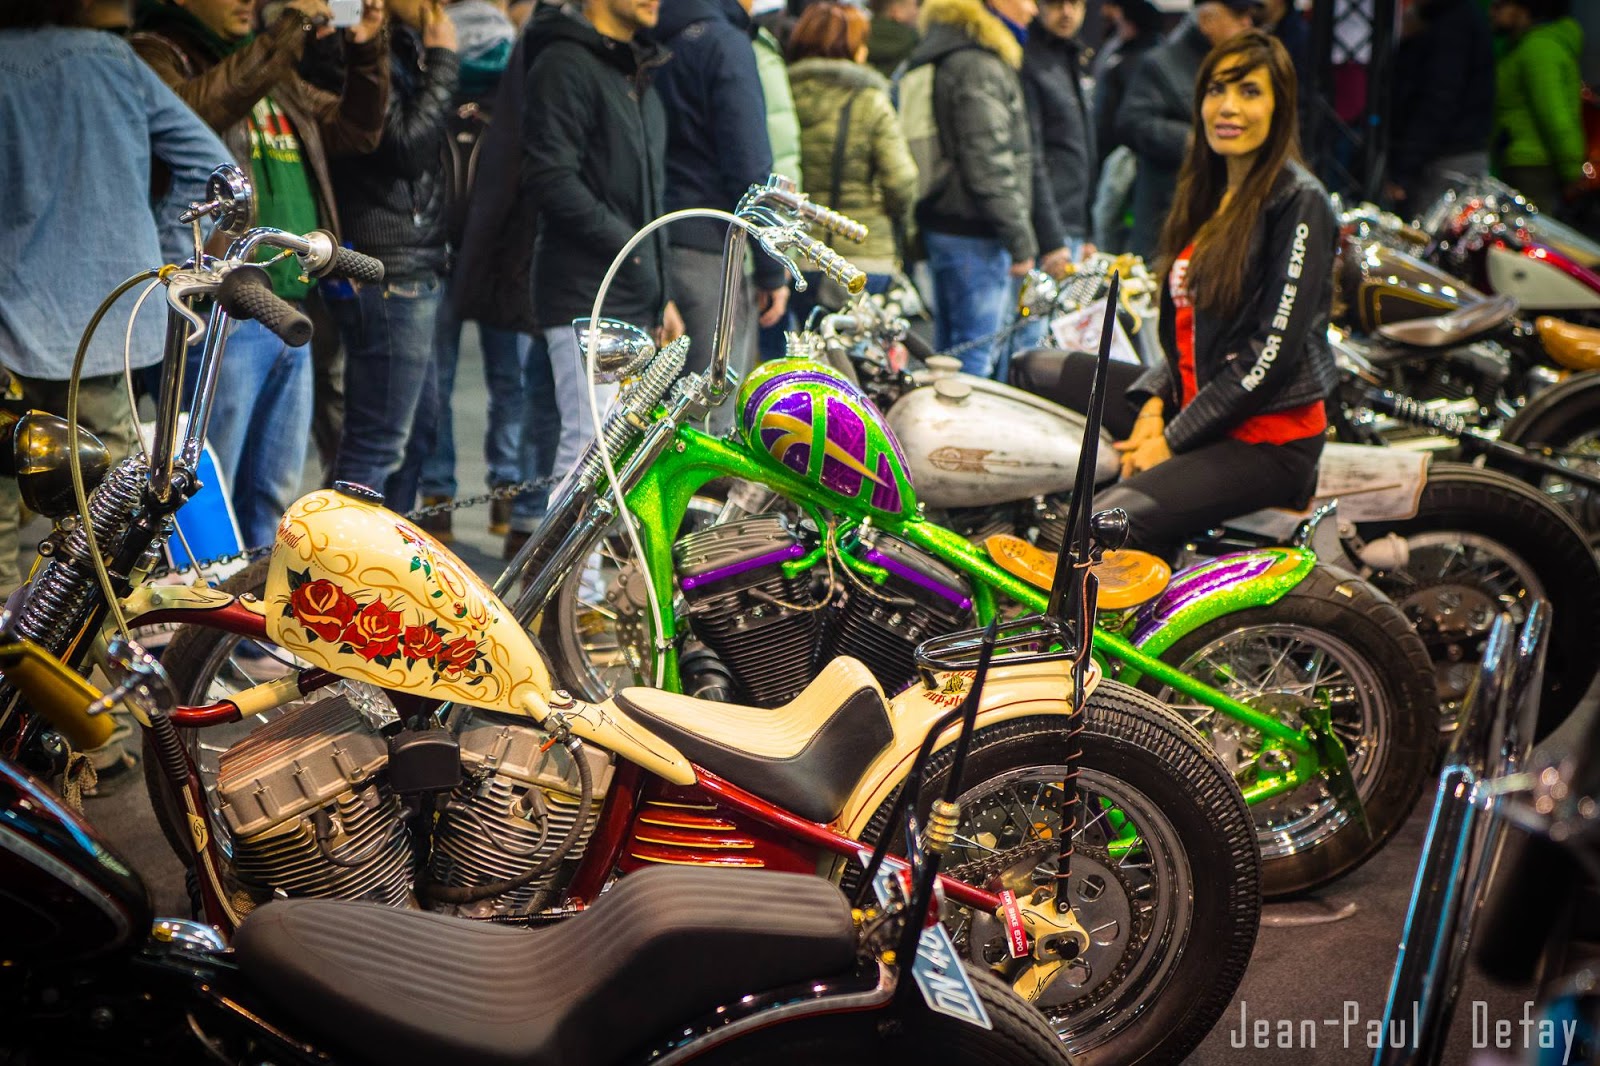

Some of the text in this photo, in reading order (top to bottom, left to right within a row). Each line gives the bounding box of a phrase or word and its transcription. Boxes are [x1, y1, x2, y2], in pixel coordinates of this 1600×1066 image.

[1241, 223, 1310, 392] MOTOR BIKE EXPO
[1008, 907, 1019, 928] BIKE
[1013, 929, 1024, 952] EXPO
